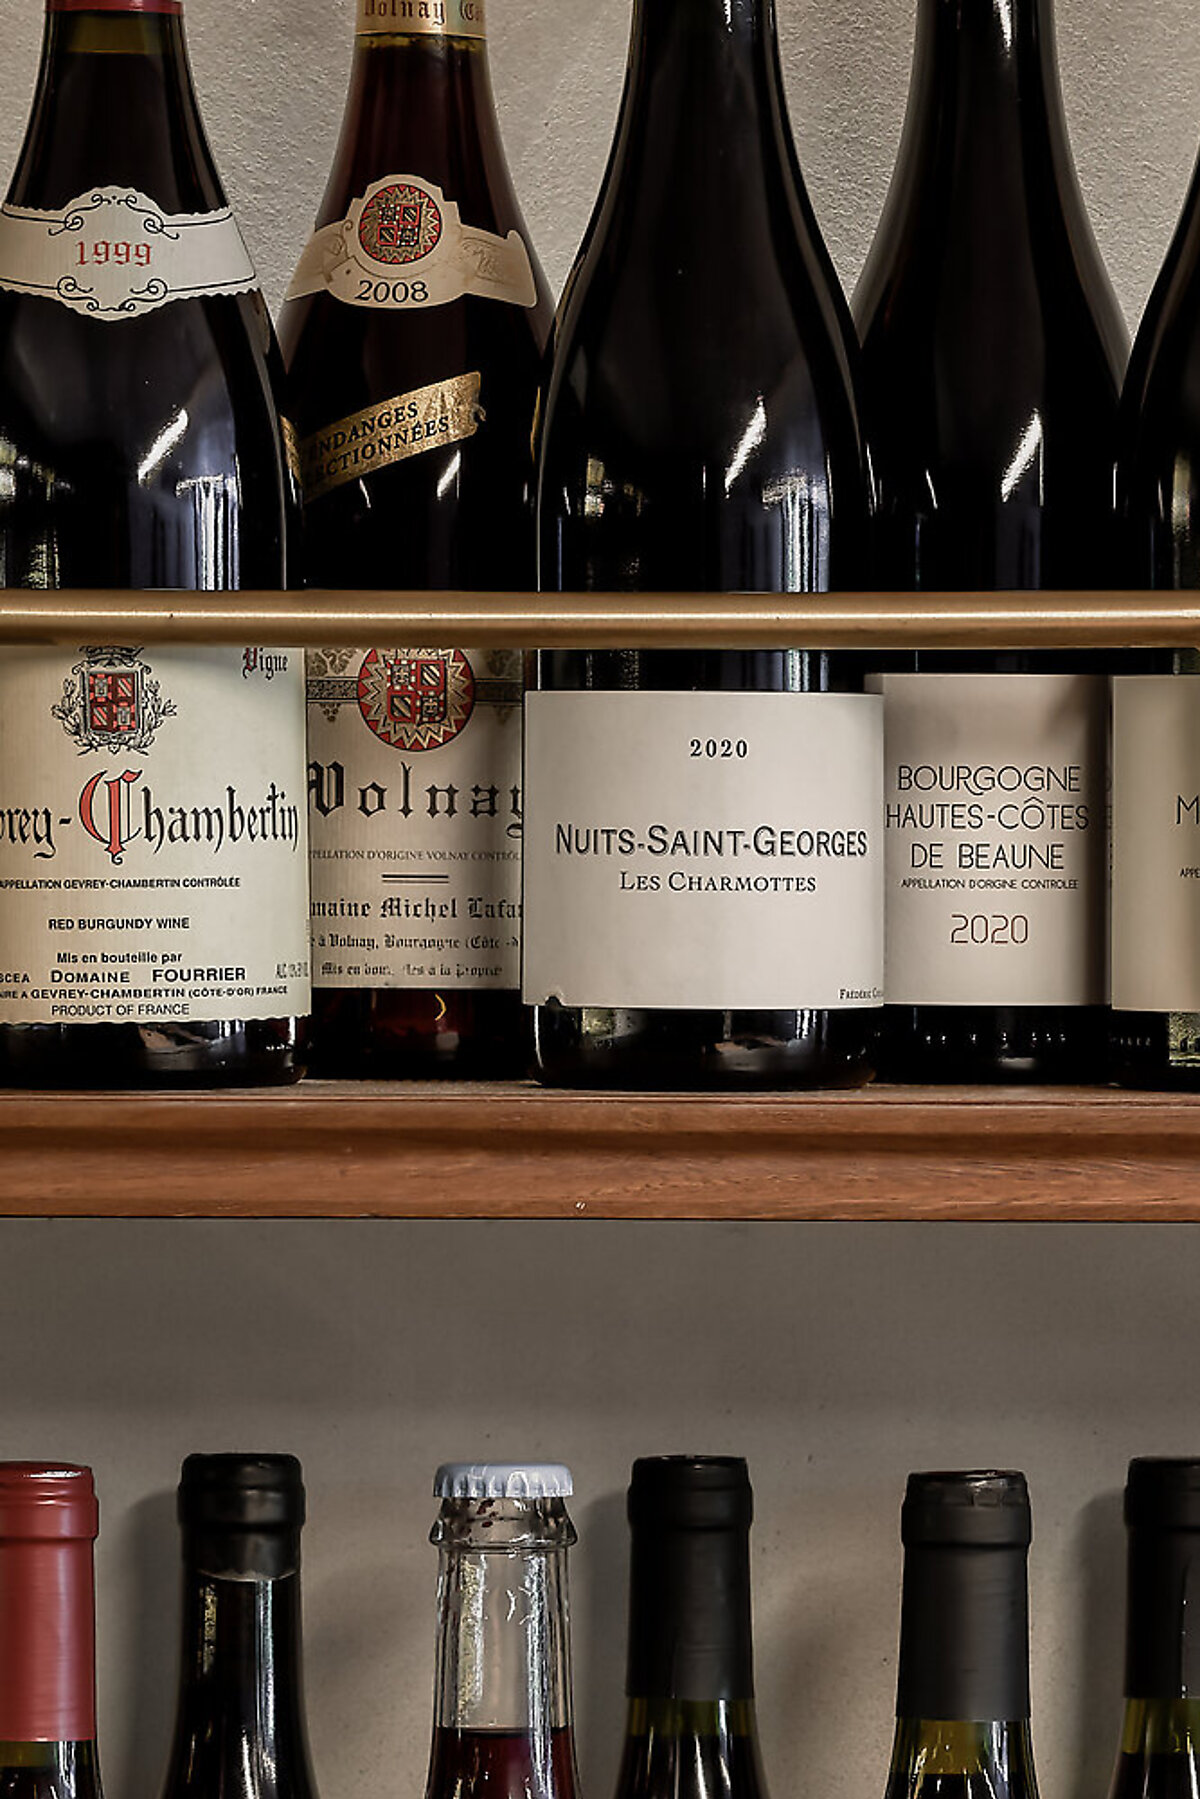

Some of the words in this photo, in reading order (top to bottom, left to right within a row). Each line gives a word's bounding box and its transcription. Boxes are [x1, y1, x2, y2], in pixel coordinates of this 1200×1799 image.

[75, 240, 153, 267] 1999
[354, 279, 429, 302] 2008
[316, 402, 418, 457] NDANGES
[690, 739, 749, 758] 2020
[899, 766, 1081, 796] BOURGOGNE
[886, 796, 1090, 830] HAUTES-CÔTES
[556, 823, 868, 857] NUITS-SAINT-GEORGES
[911, 843, 944, 869] DE
[958, 843, 1065, 870] BEAUNE
[620, 870, 661, 891] LES
[668, 871, 817, 892] CHARMOTTES
[901, 879, 965, 890] APPELLATION
[381, 897, 458, 923] Michel
[48, 919, 75, 930] RED
[78, 918, 153, 930] BURGUNDY
[156, 917, 190, 930] WINE
[951, 914, 1029, 944] 2020
[57, 952, 79, 964] Mis
[82, 954, 98, 963] en
[161, 953, 183, 967] par
[51, 969, 130, 983] DOMAINE
[152, 967, 246, 983] FOURRIER
[31, 988, 185, 1000] GEVREY-CHAMBERTIN
[51, 1004, 113, 1016] PRODUCT
[116, 1004, 135, 1016] OF
[138, 1003, 190, 1016] FRANCE
